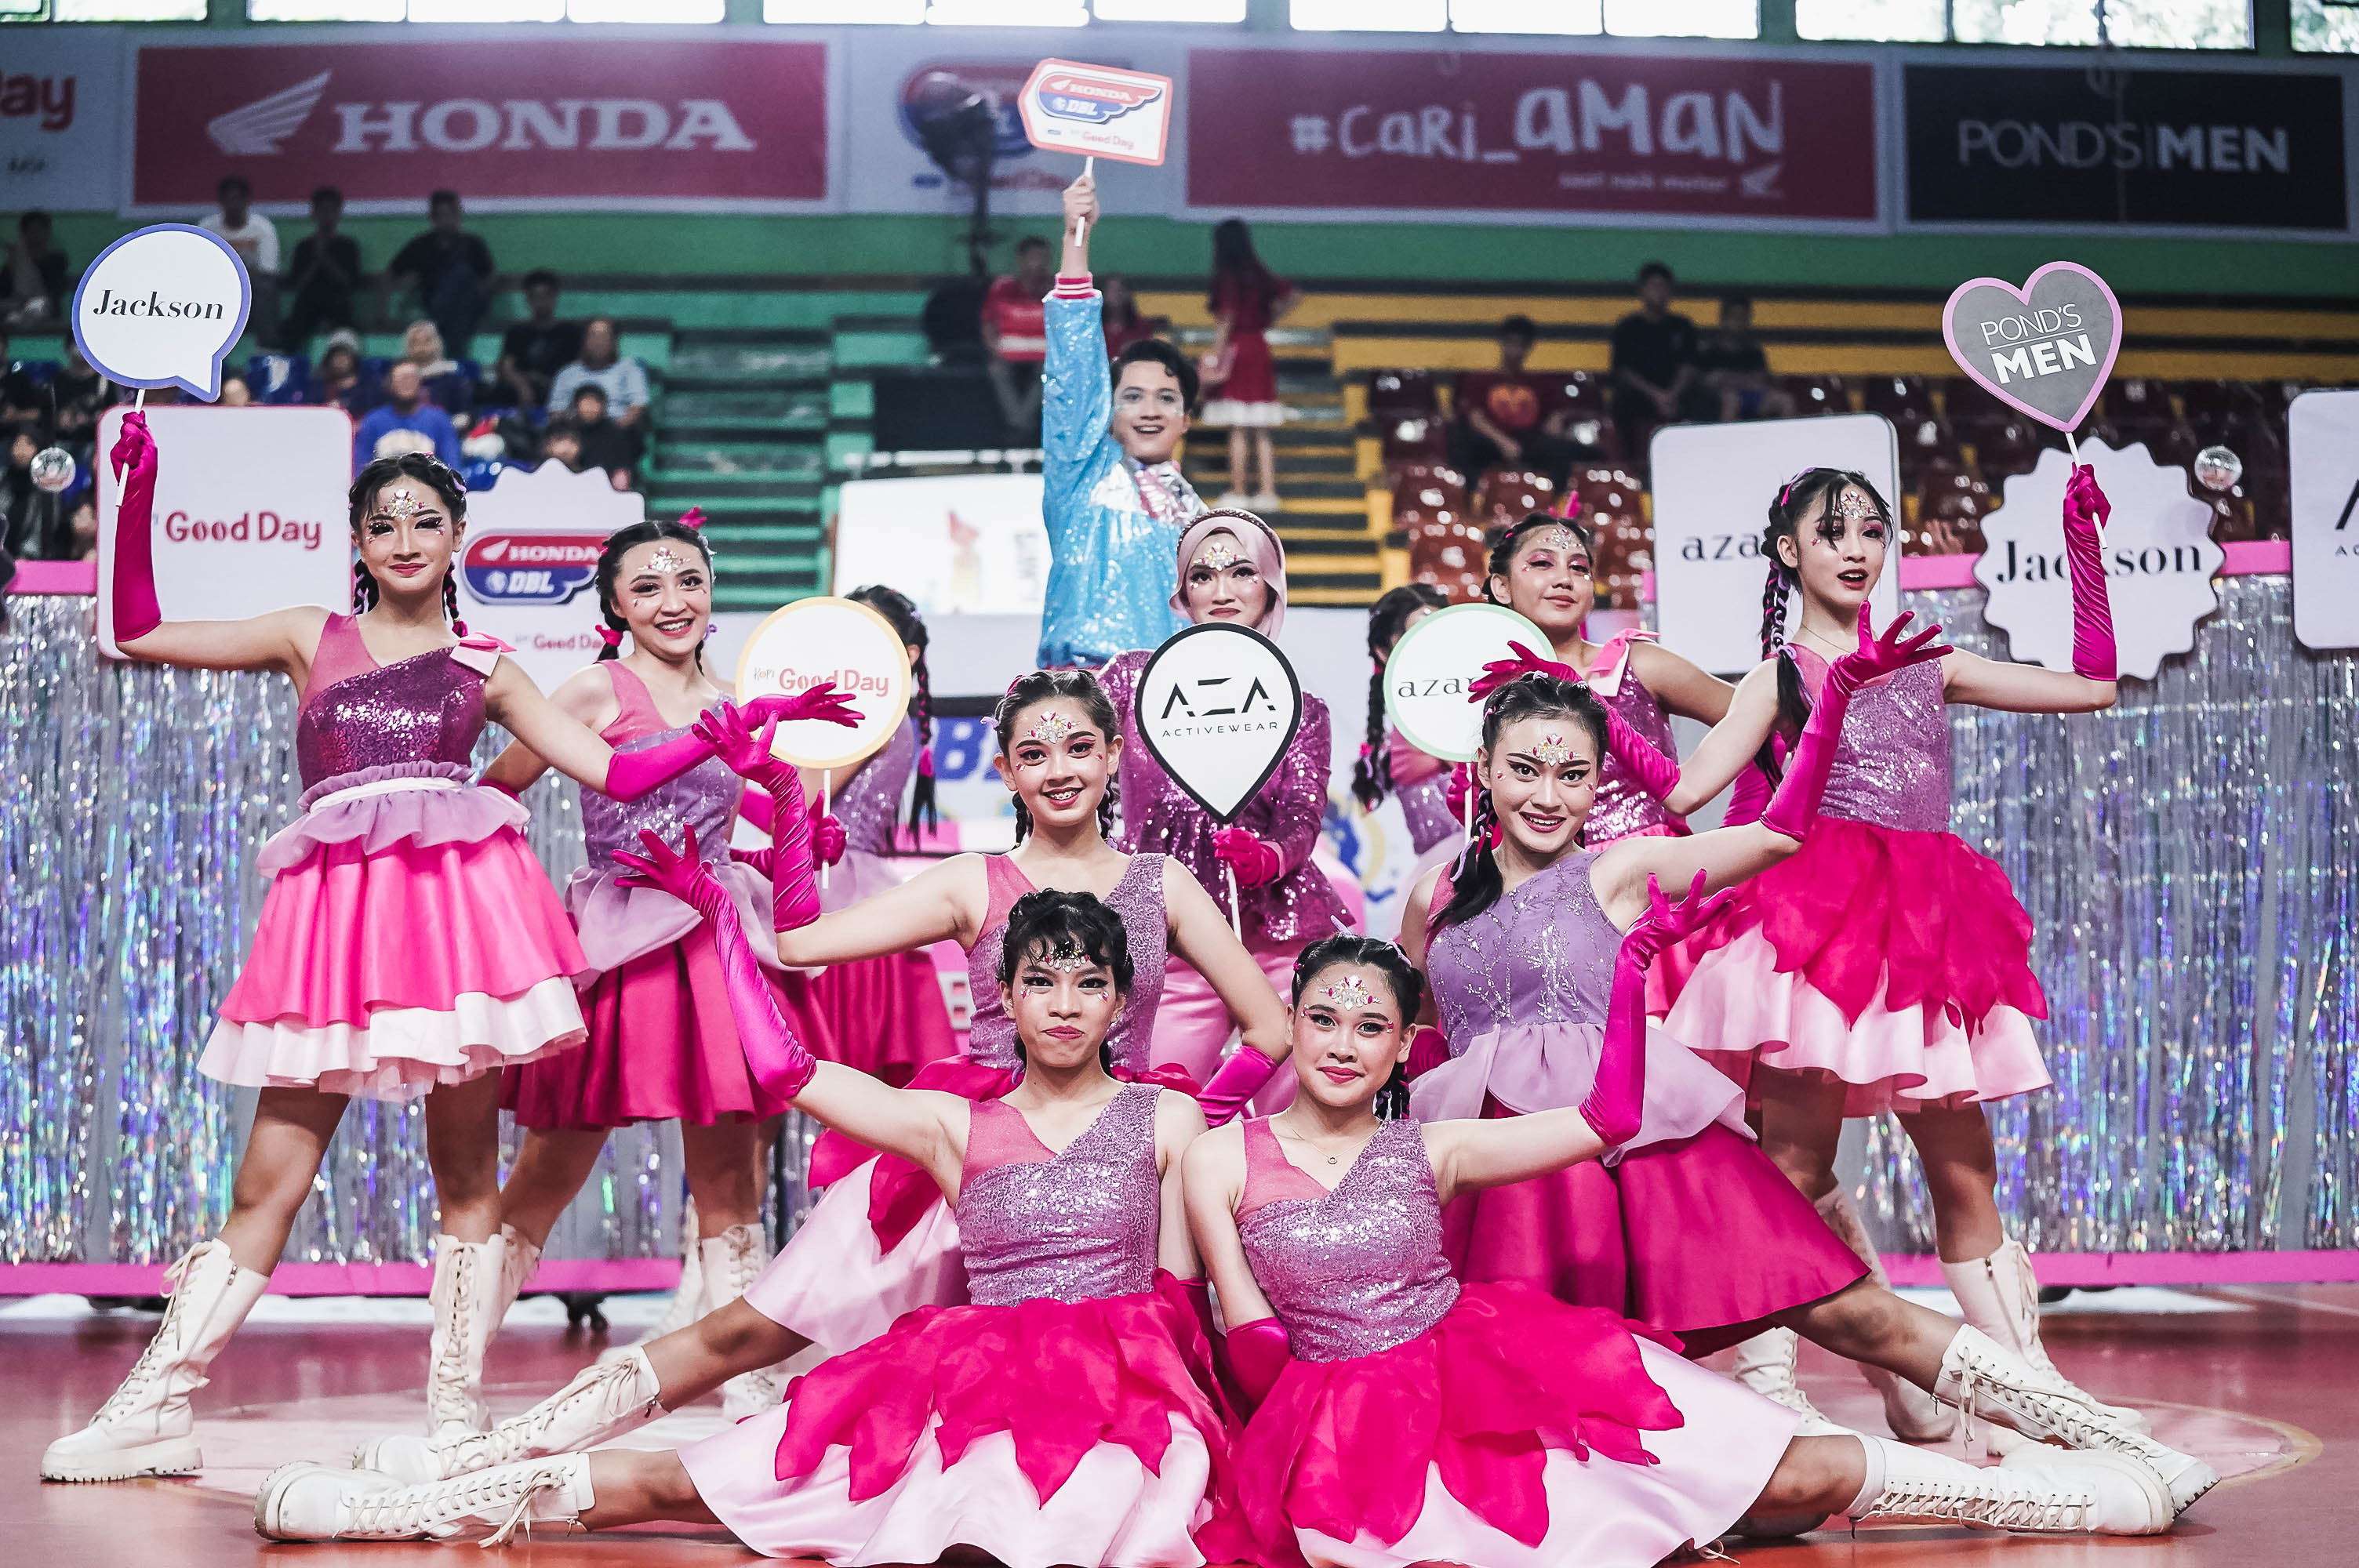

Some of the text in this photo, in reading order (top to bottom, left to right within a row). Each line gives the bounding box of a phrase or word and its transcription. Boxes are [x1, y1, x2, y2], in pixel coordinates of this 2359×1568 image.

[0, 71, 76, 134] ay
[1068, 84, 1133, 101] HONDA
[331, 98, 758, 153] HONDA
[2156, 123, 2292, 174] MEN
[93, 289, 224, 320] Jackson
[1980, 303, 2083, 346] POND'S
[1991, 334, 2097, 384] MEN
[165, 511, 322, 551] Good Day
[510, 545, 600, 561] HONDA
[1997, 540, 2201, 583] Jacson
[507, 571, 554, 593] DBL
[580, 633, 604, 650] Da
[844, 670, 890, 697] Day
[1162, 721, 1278, 738] ACTIVEWEAR
